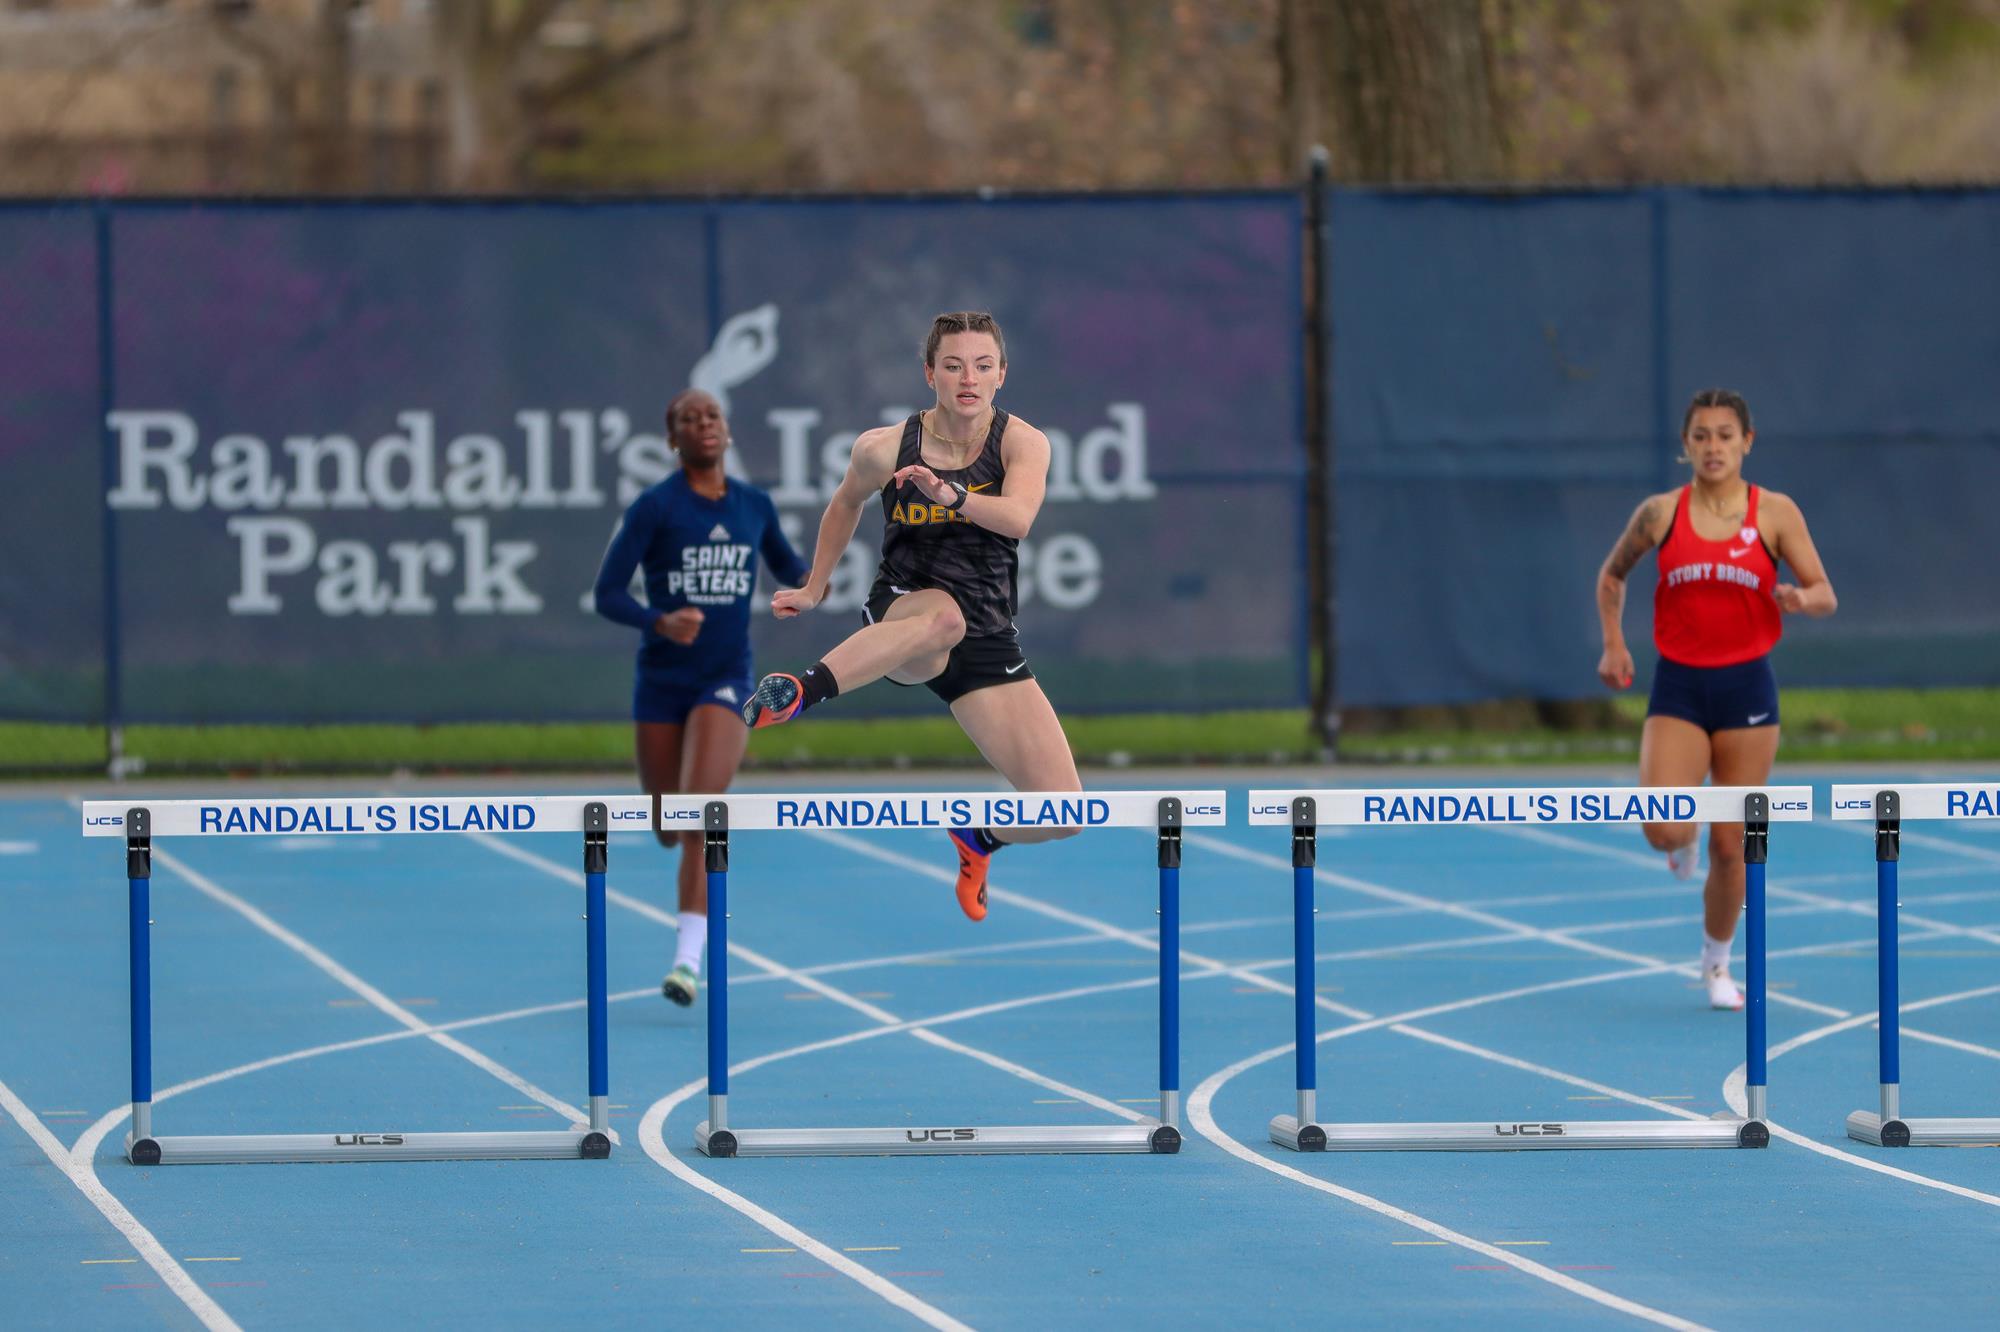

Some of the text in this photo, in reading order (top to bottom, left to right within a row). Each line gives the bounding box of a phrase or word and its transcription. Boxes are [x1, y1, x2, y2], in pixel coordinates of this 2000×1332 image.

[107, 409, 681, 508] Randall's
[892, 501, 972, 525] ADEL
[682, 545, 752, 571] SAINT
[227, 516, 543, 615] Park
[1668, 562, 1760, 590] STONY BROOK
[1364, 793, 1697, 822] RANDALL'S ISLAND
[1771, 802, 1808, 811] UCS
[1835, 801, 1872, 810] UCS
[1947, 790, 2000, 816] RA
[611, 811, 648, 820] UCS
[664, 810, 701, 819] UCS
[777, 799, 1109, 827] RANDALL'S ISLAND
[1185, 806, 1221, 815] UCS
[1253, 806, 1289, 815] UCS
[86, 816, 123, 826] UCS
[200, 804, 535, 832] RANDALL'S ISLAND
[906, 1128, 975, 1142] UCS
[1495, 1124, 1563, 1136] UCS
[335, 1133, 405, 1146] UCS
